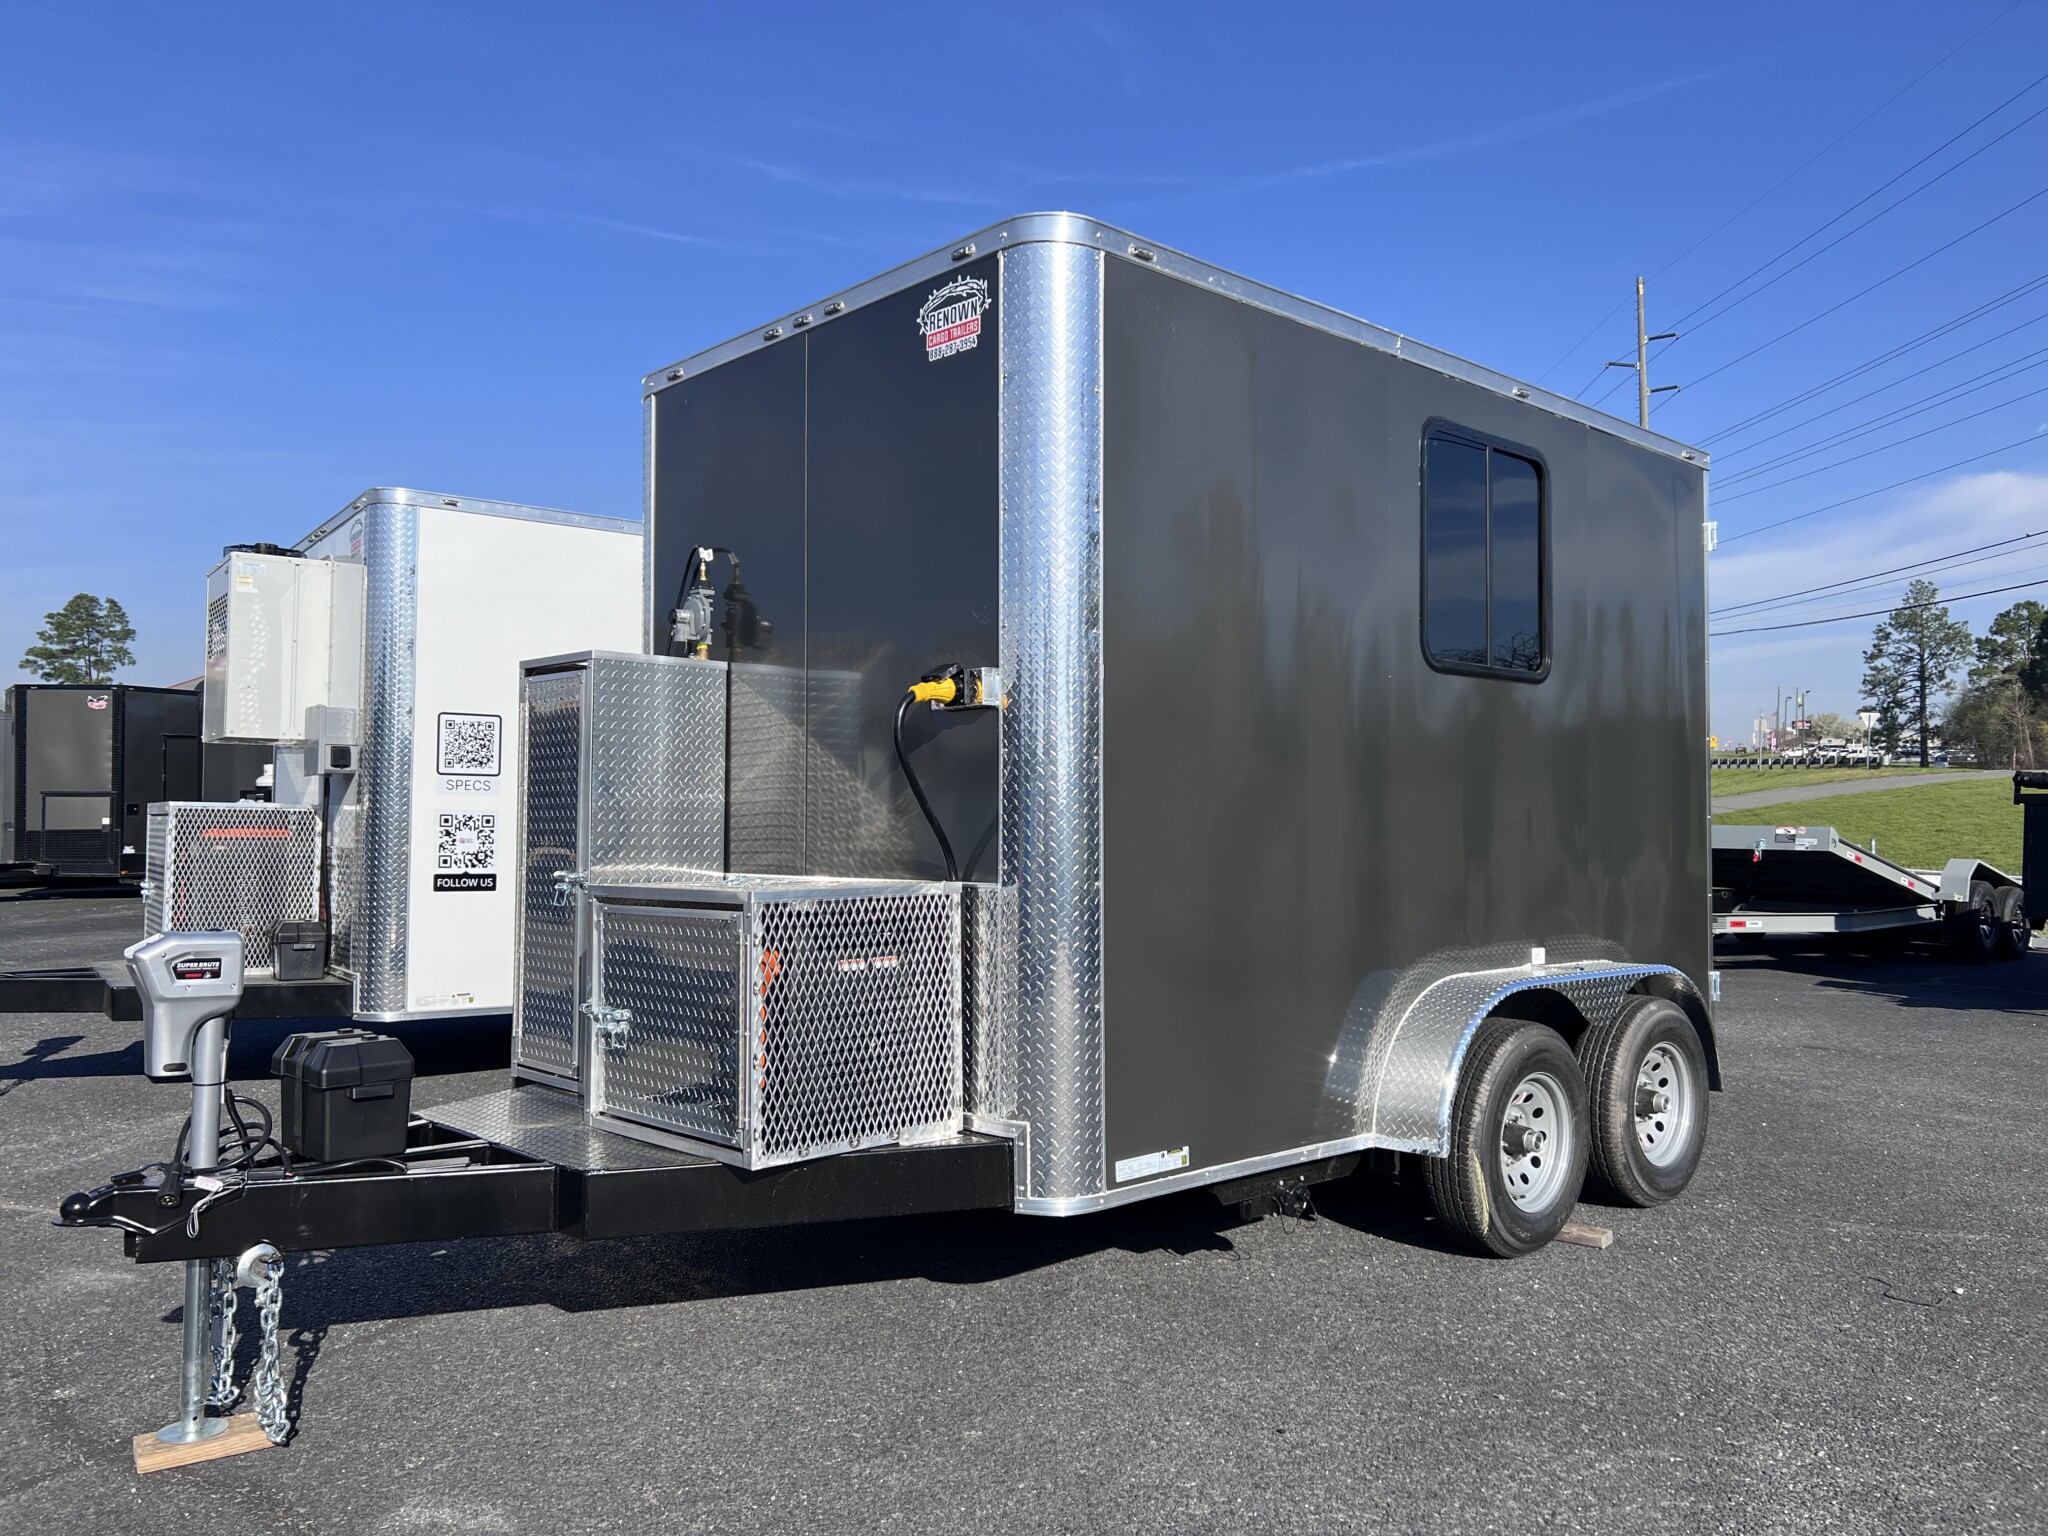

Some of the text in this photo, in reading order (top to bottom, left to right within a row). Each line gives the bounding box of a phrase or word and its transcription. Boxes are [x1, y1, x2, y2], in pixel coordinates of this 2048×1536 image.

[929, 298, 978, 332] RENOWN
[928, 320, 979, 347] CARGO TRAILERS
[446, 779, 491, 791] SPECS
[437, 878, 494, 888] FOLLOW US
